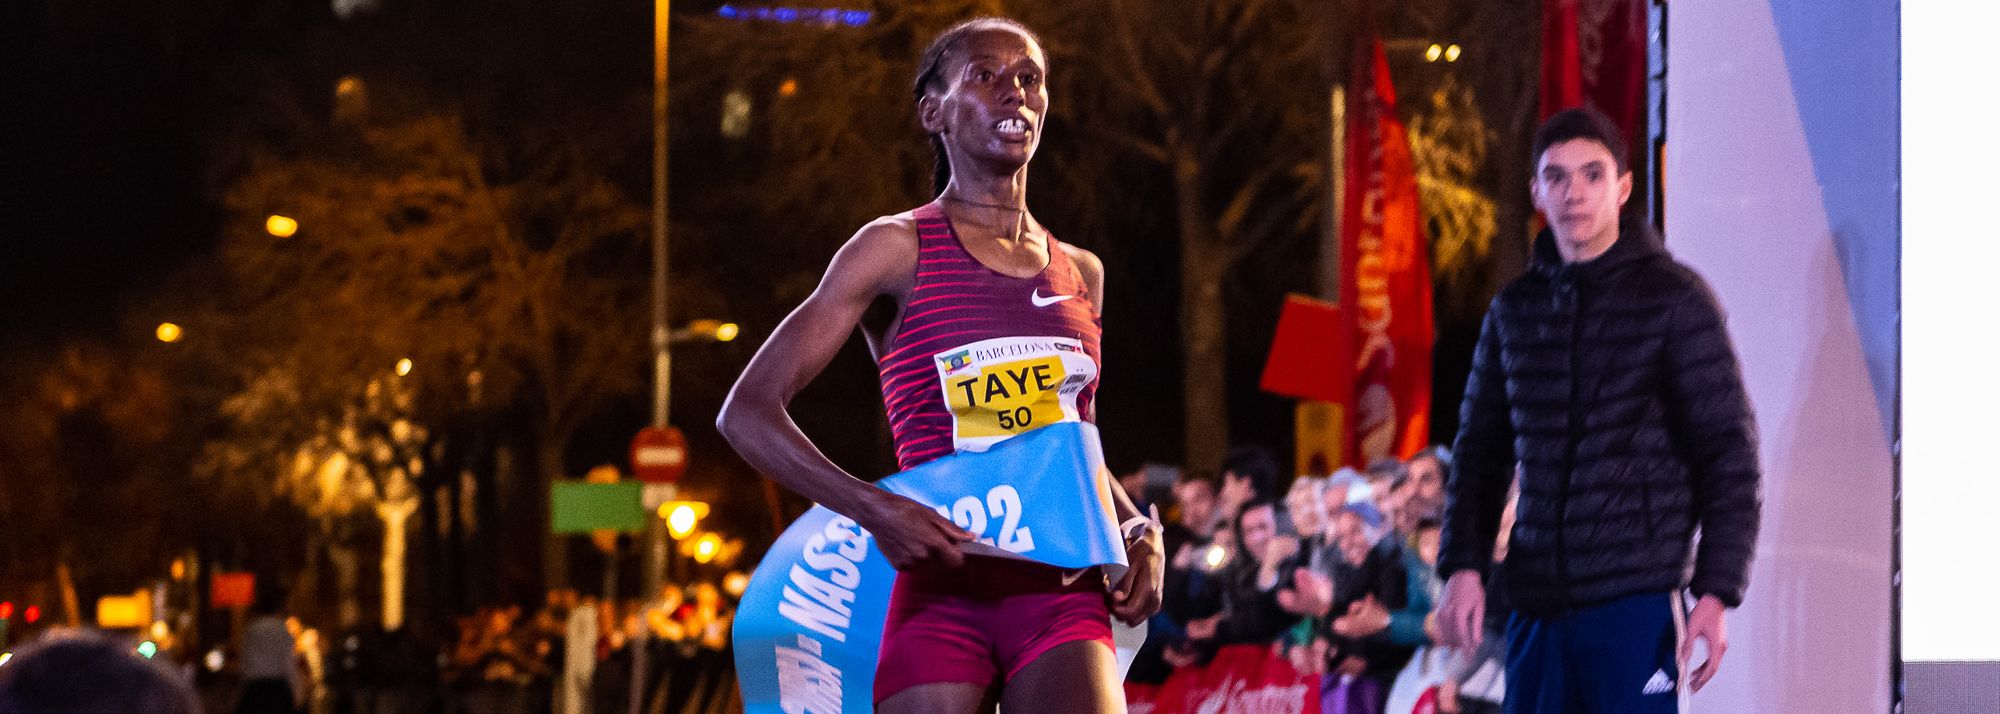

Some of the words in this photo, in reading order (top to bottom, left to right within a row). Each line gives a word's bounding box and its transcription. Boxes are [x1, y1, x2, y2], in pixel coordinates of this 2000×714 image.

[976, 342, 1053, 362] BARCELONA
[957, 364, 1055, 407] TAYE
[997, 406, 1032, 430] 50
[937, 484, 1036, 554] 22
